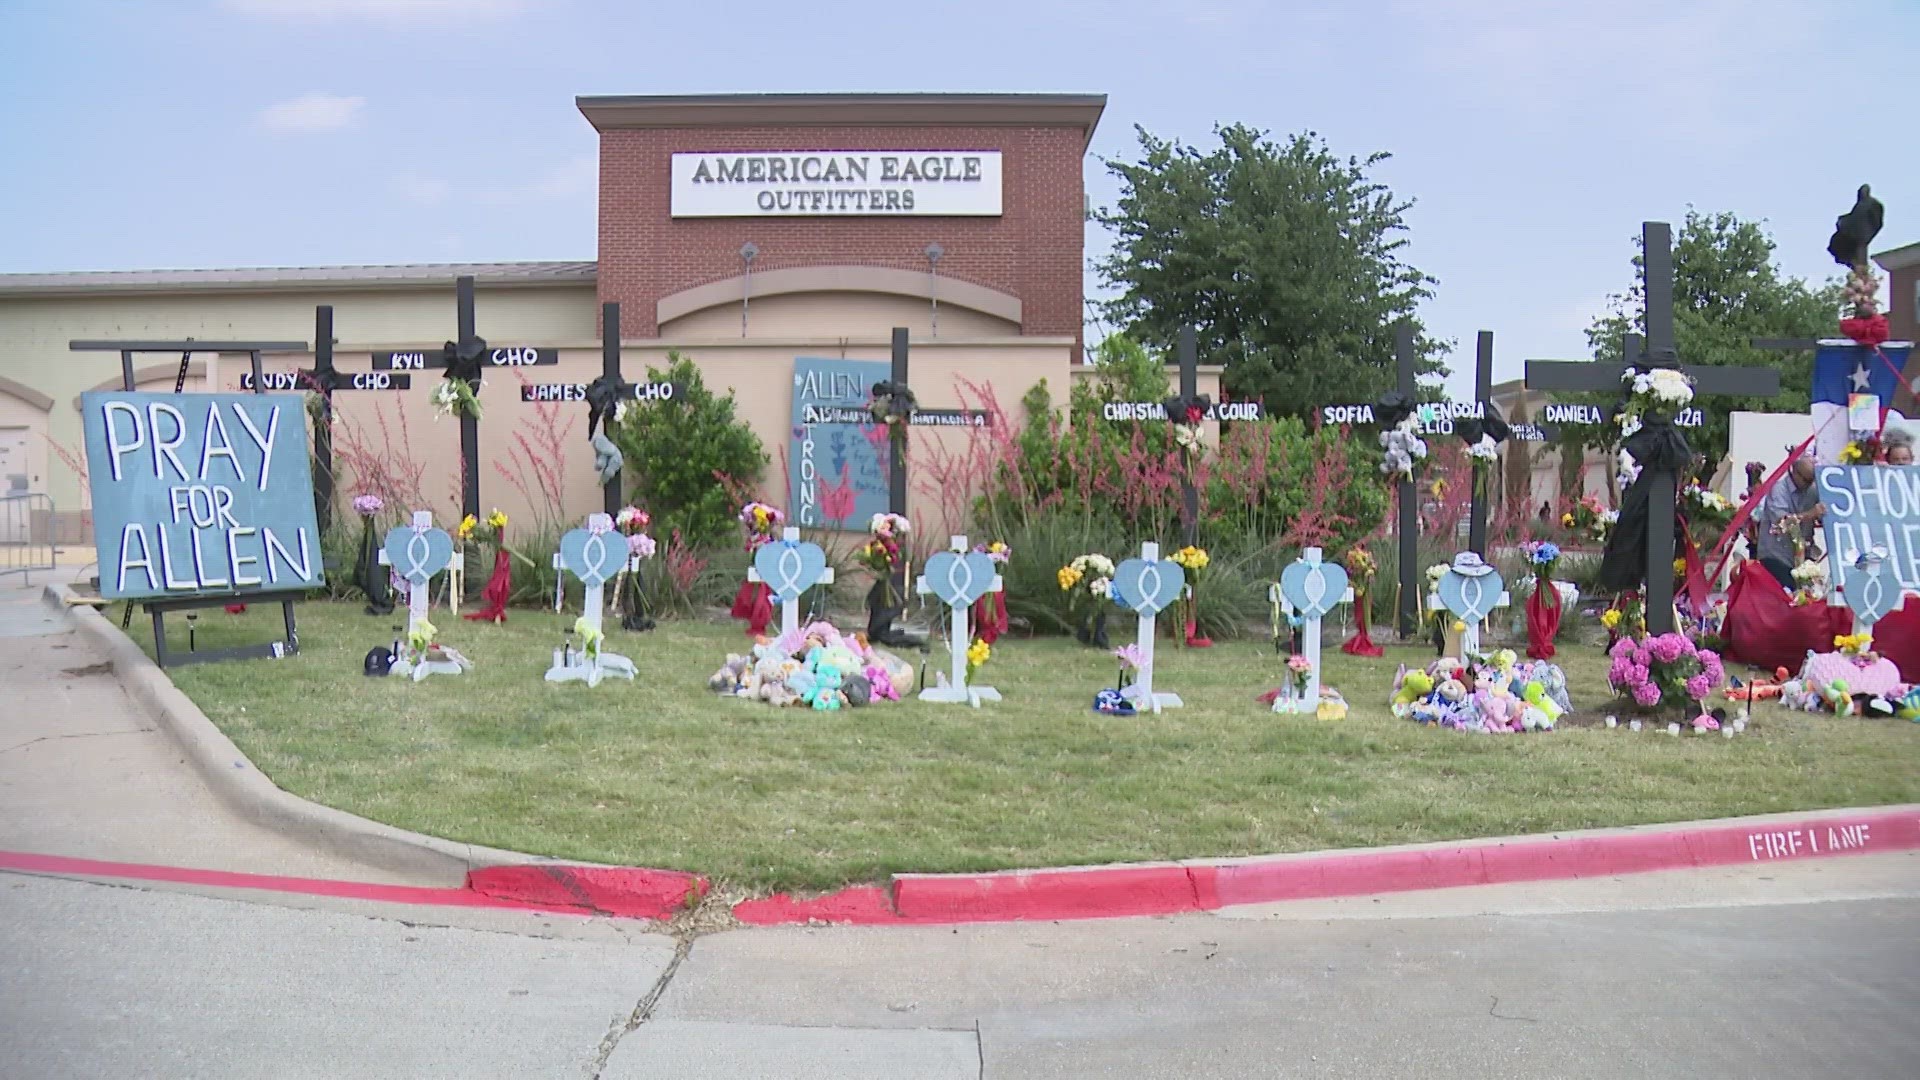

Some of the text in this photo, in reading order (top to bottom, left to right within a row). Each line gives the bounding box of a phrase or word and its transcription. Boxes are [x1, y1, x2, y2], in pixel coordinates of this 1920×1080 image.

[692, 156, 982, 183] AMERICAN EAGLE
[757, 189, 915, 211] OUTFITTERS
[391, 348, 538, 369] KYU CHO
[244, 373, 391, 390] CNDY CHO
[526, 382, 673, 400] JAMES CHO
[1218, 402, 1260, 421] COUR
[1324, 405, 1375, 424] SOFIA
[1546, 405, 1603, 424] DANIELA
[102, 401, 280, 492] PRAY
[800, 402, 816, 526] TRONG
[169, 485, 241, 529] FOR
[117, 521, 312, 591] ALLEN
[1748, 830, 1803, 860] FIRE
